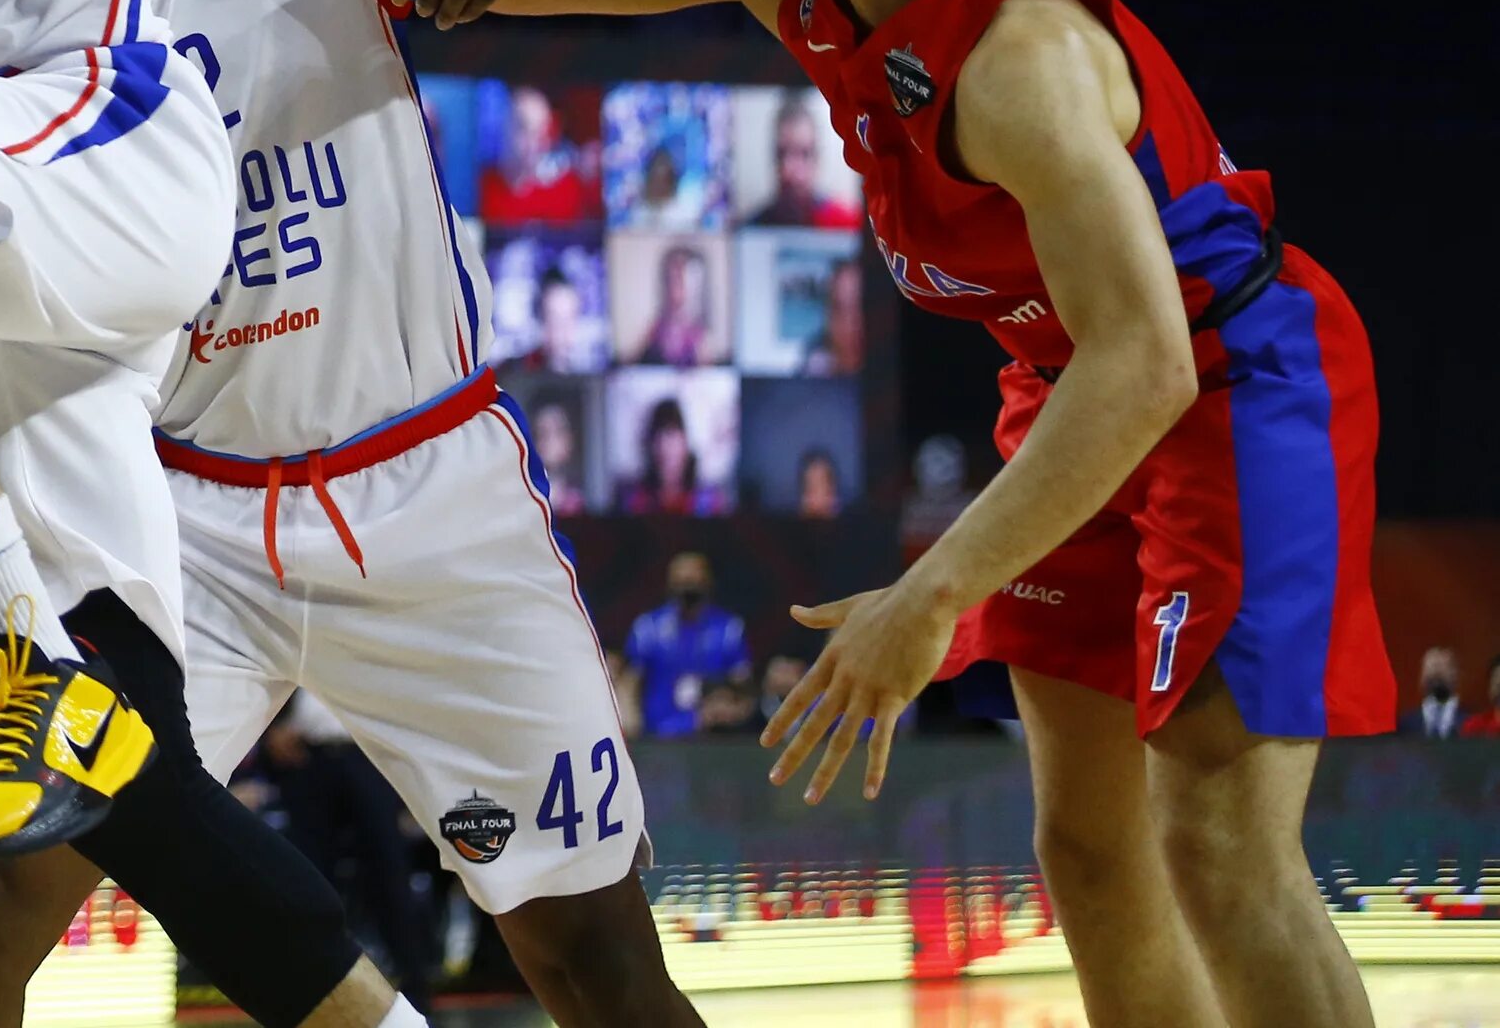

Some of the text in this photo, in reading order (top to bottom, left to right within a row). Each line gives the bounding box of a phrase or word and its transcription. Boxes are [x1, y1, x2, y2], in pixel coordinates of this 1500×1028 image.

[902, 76, 930, 99] FOUR
[1014, 582, 1066, 605] UAC
[1152, 591, 1189, 692] 1
[536, 737, 623, 849] 42
[445, 818, 511, 832] FINAL FOUR
